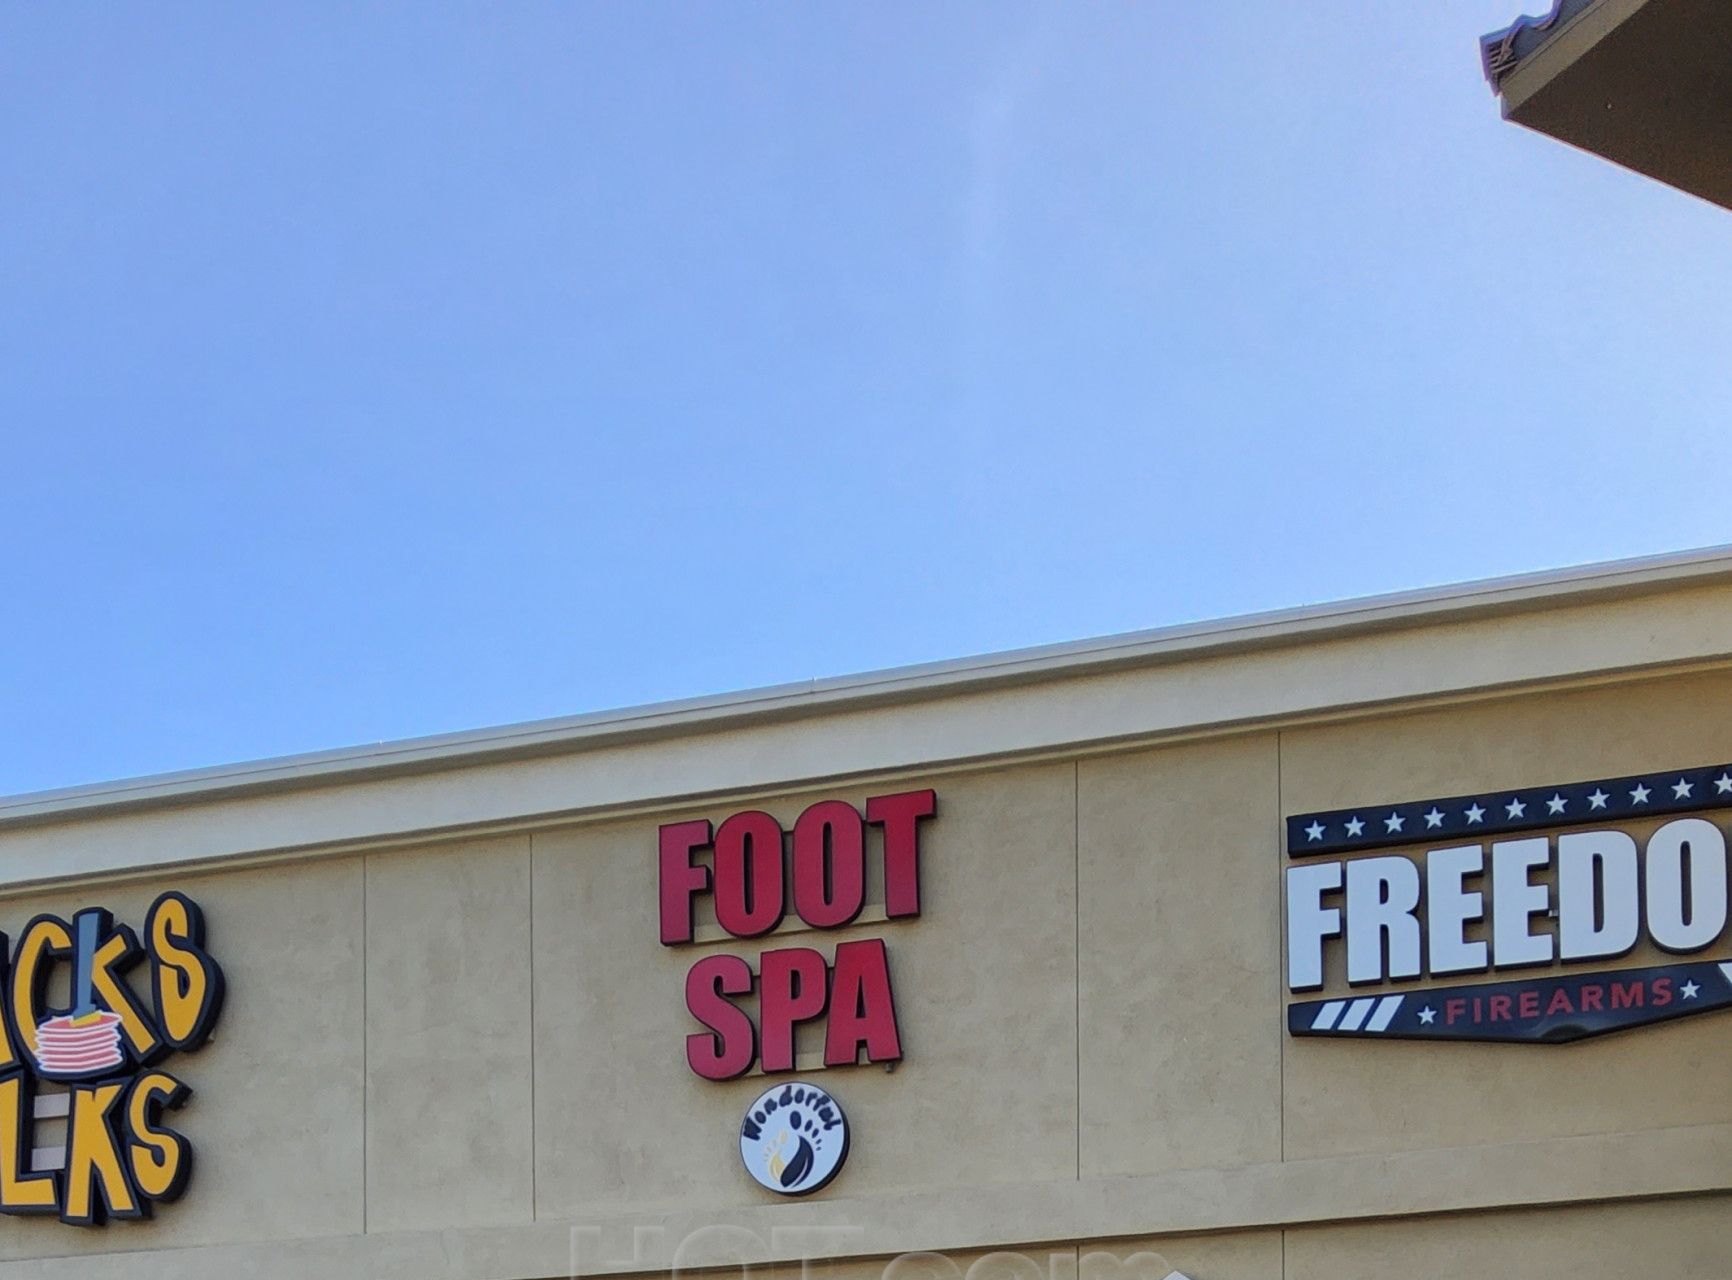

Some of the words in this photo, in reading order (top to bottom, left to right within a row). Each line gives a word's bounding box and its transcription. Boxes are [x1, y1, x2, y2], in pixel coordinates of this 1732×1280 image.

[659, 789, 936, 945] FOOT
[1287, 818, 1729, 992] FREEDO
[0, 893, 222, 1068] CKS
[686, 938, 903, 1081] SPA
[1446, 977, 1673, 1025] FIREARMS
[743, 1085, 841, 1140] Wonderful
